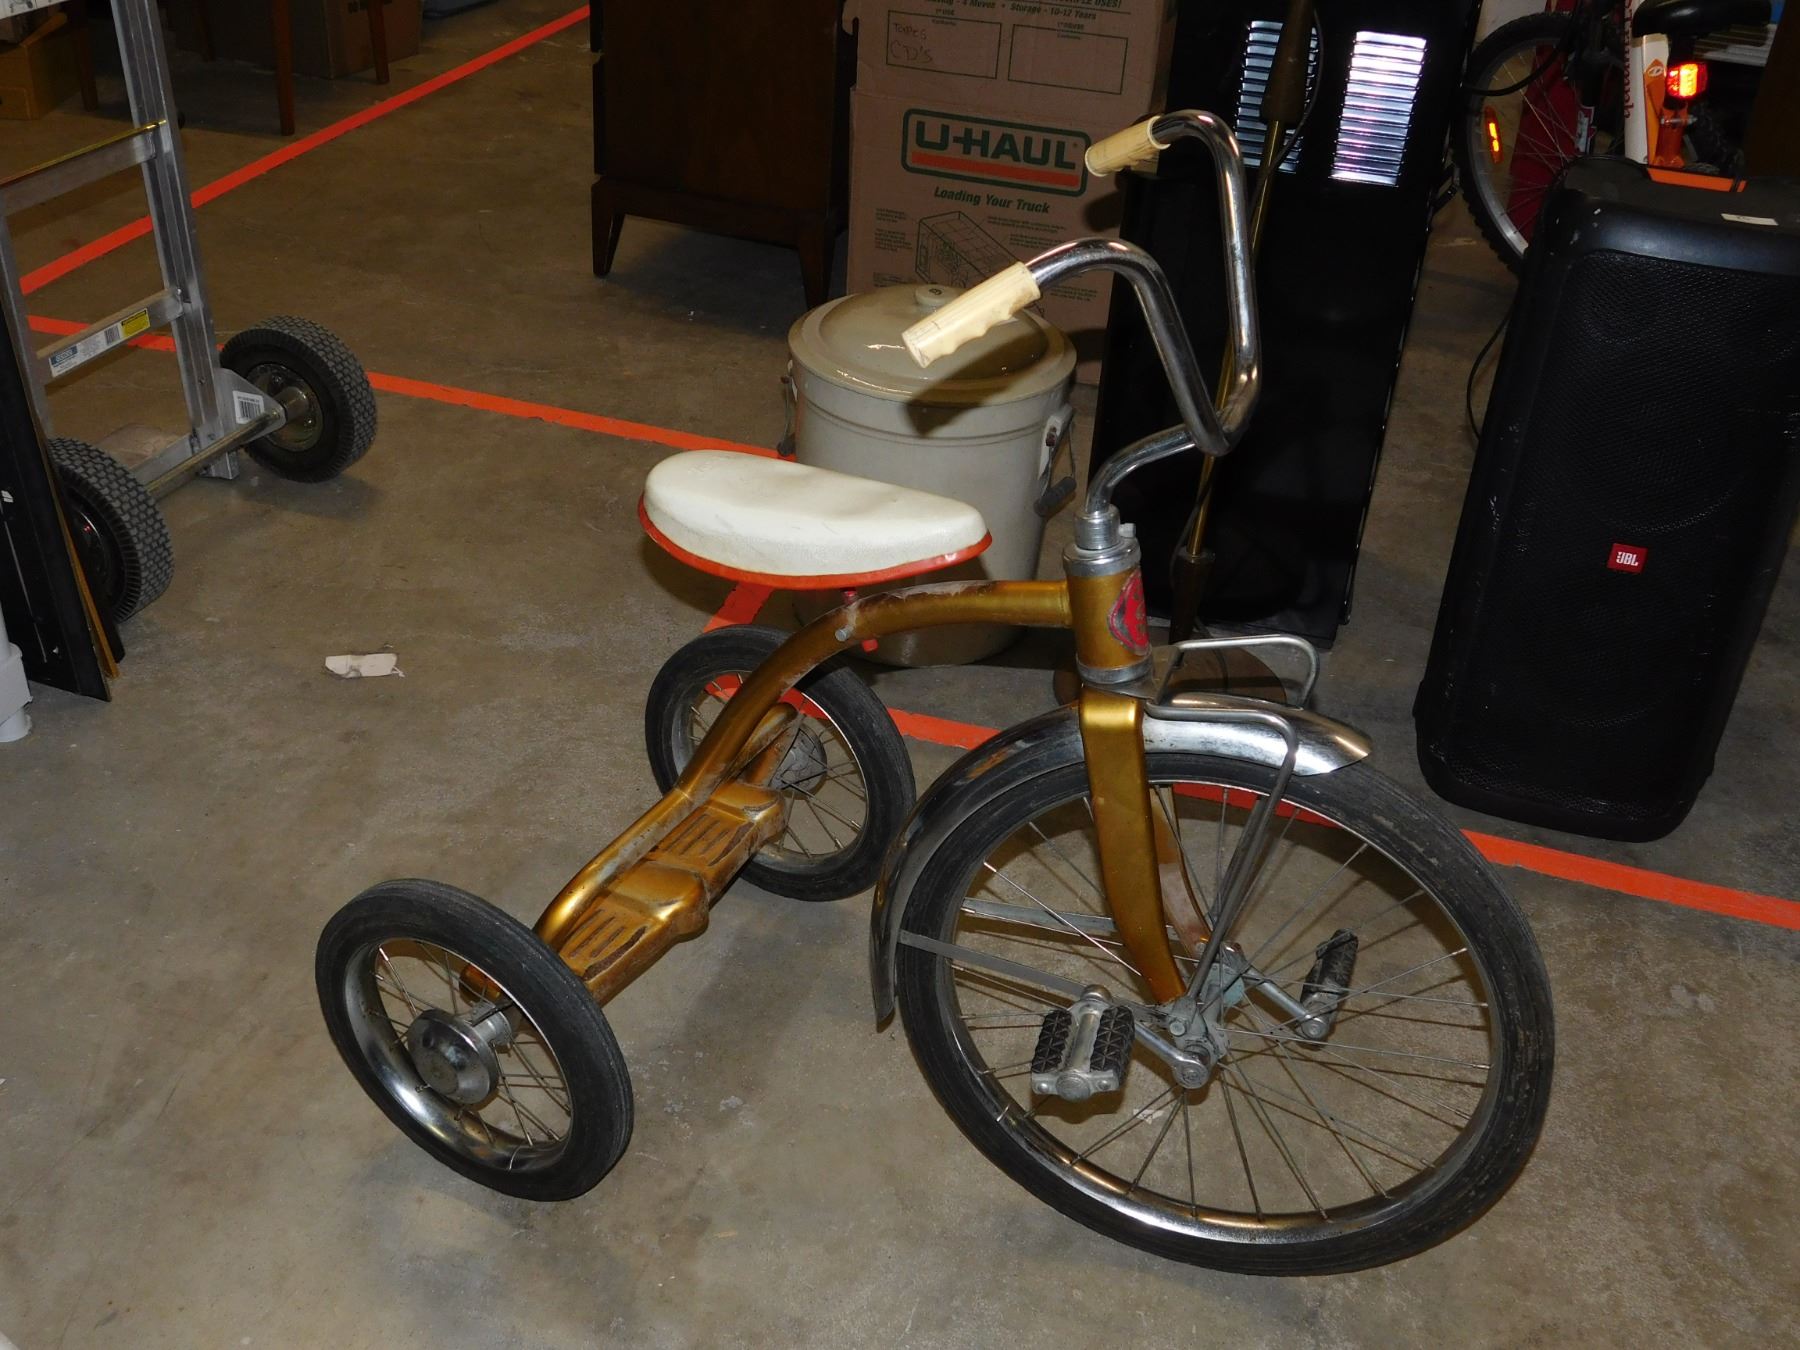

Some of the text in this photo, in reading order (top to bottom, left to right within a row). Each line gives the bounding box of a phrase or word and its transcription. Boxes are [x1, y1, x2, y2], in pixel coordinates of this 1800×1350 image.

[1010, 3, 1042, 14] Storage
[1050, 7, 1073, 17] 10-12
[1074, 10, 1097, 20] Years
[916, 121, 1076, 169] U-HAUL
[934, 186, 1051, 214] Loading Your Truck
[1615, 551, 1639, 567] JBL
